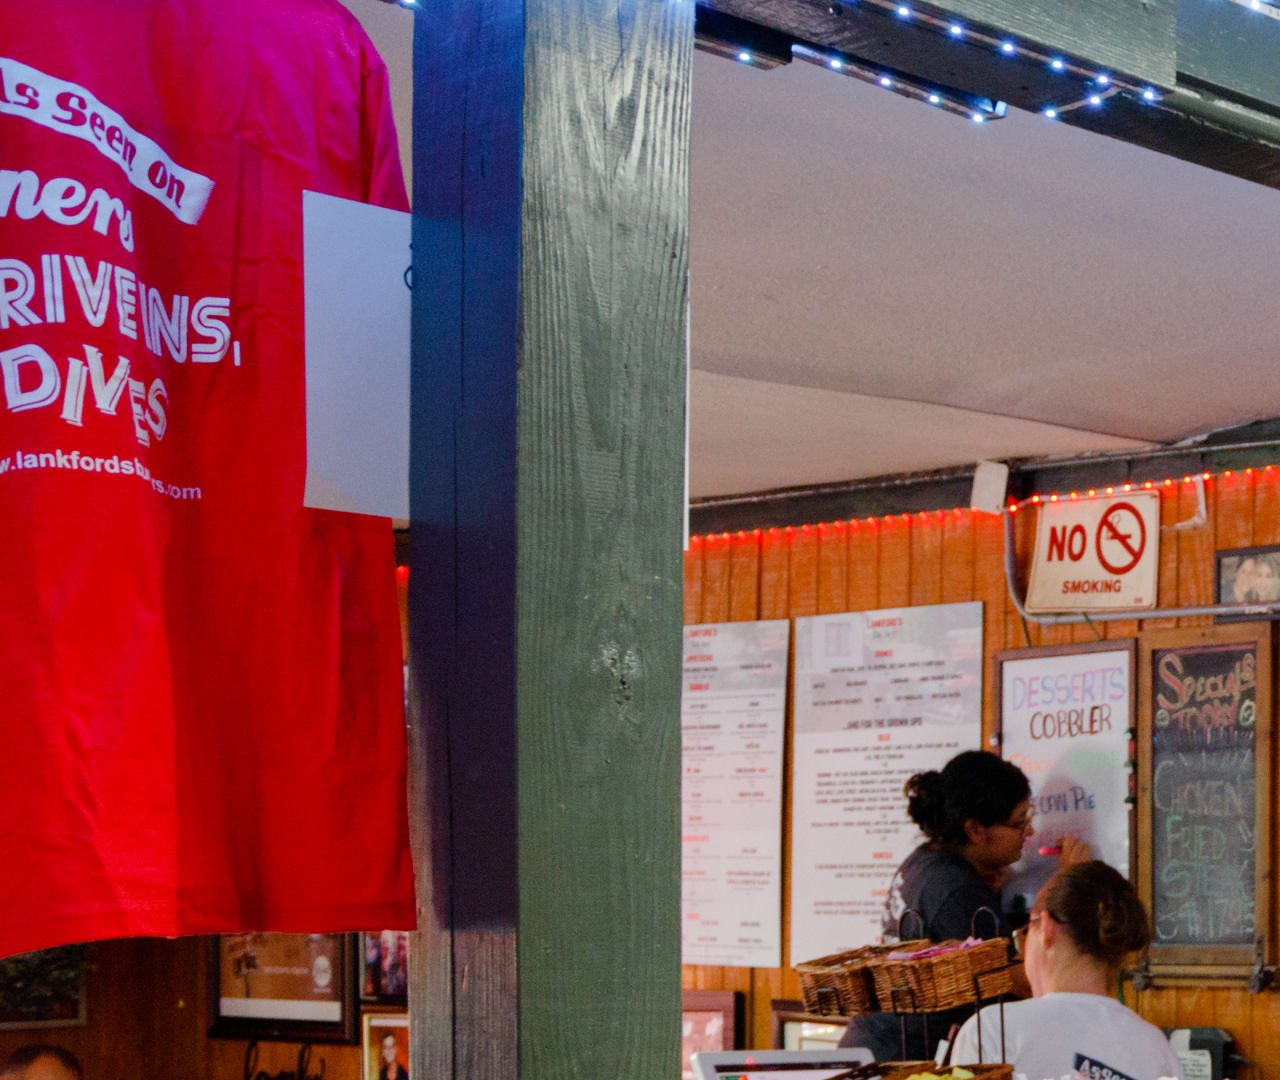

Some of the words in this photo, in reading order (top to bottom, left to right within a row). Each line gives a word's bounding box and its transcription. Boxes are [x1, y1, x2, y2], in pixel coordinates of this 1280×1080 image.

[0, 66, 40, 110] s
[52, 91, 137, 171] Seen
[0, 169, 135, 252] ners
[0, 343, 170, 447] DIVES
[1047, 524, 1087, 562] NO
[1061, 579, 1122, 595] SMOKING
[1012, 666, 1126, 711] DESSERTS
[1030, 703, 1112, 740] COBBLER
[1165, 815, 1226, 861] FRIED
